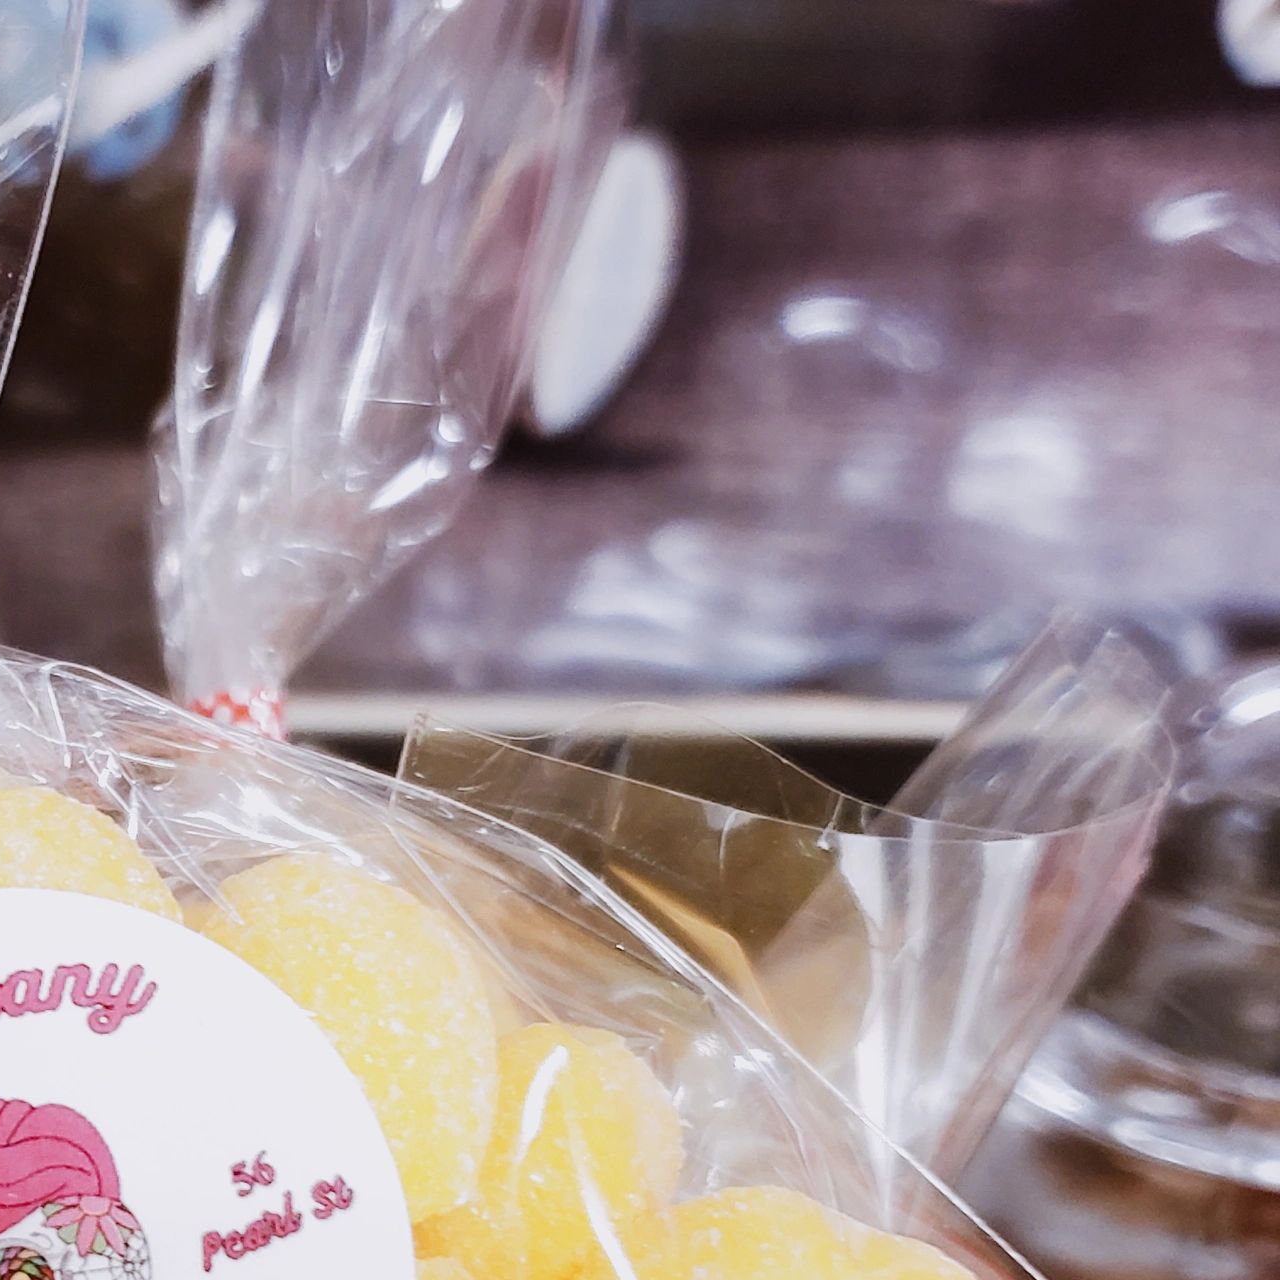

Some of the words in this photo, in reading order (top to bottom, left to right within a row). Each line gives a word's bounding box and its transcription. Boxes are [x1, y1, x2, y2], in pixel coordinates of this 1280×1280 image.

[230, 1150, 276, 1197] 56
[201, 1190, 303, 1274] Pearl
[311, 1175, 354, 1221] St
